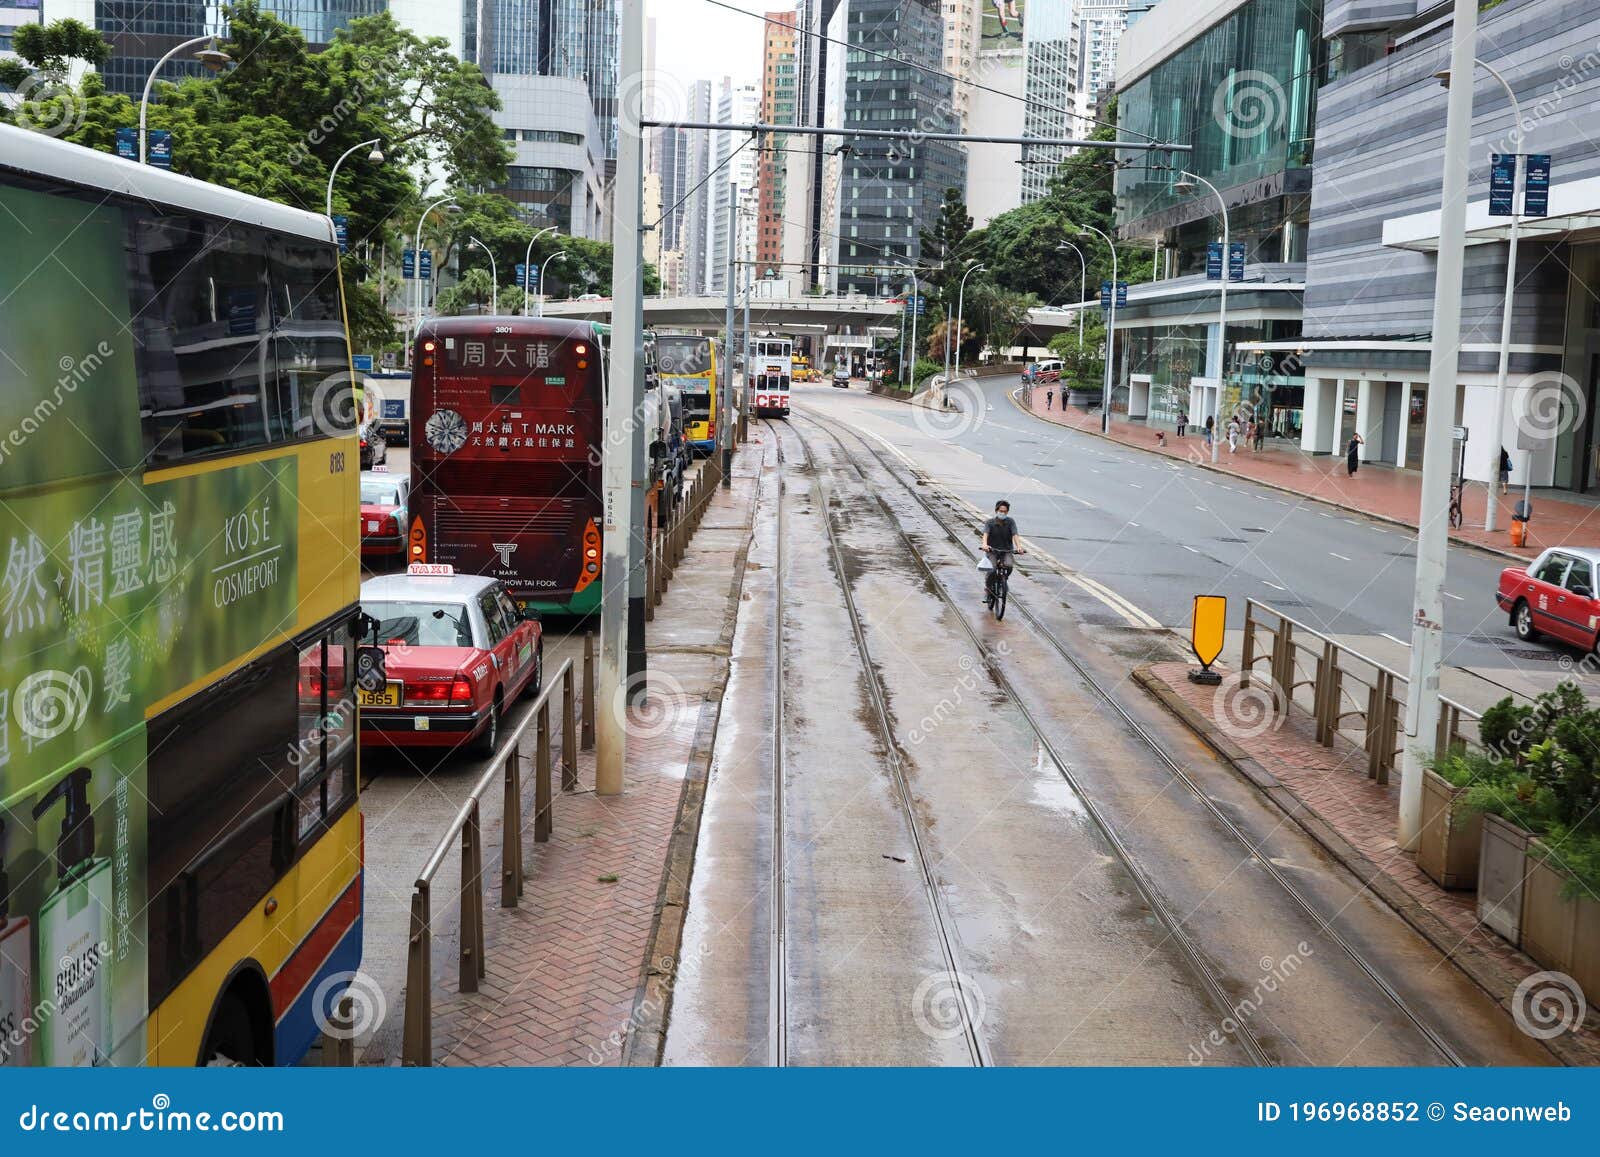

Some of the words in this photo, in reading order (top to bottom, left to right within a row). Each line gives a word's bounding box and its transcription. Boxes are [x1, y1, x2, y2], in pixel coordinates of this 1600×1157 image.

[495, 326, 513, 334] 3801
[462, 340, 549, 368] 周大福
[471, 421, 513, 434] 周大福
[521, 424, 529, 434] T
[535, 423, 575, 435] MARK
[329, 451, 345, 474] 8183
[224, 496, 271, 555] KOSÉ
[409, 564, 450, 574] TAXI
[213, 556, 280, 609] COSMEPORT
[524, 579, 535, 587] TAI
[536, 580, 557, 588] FOOK
[361, 693, 393, 705] 1965
